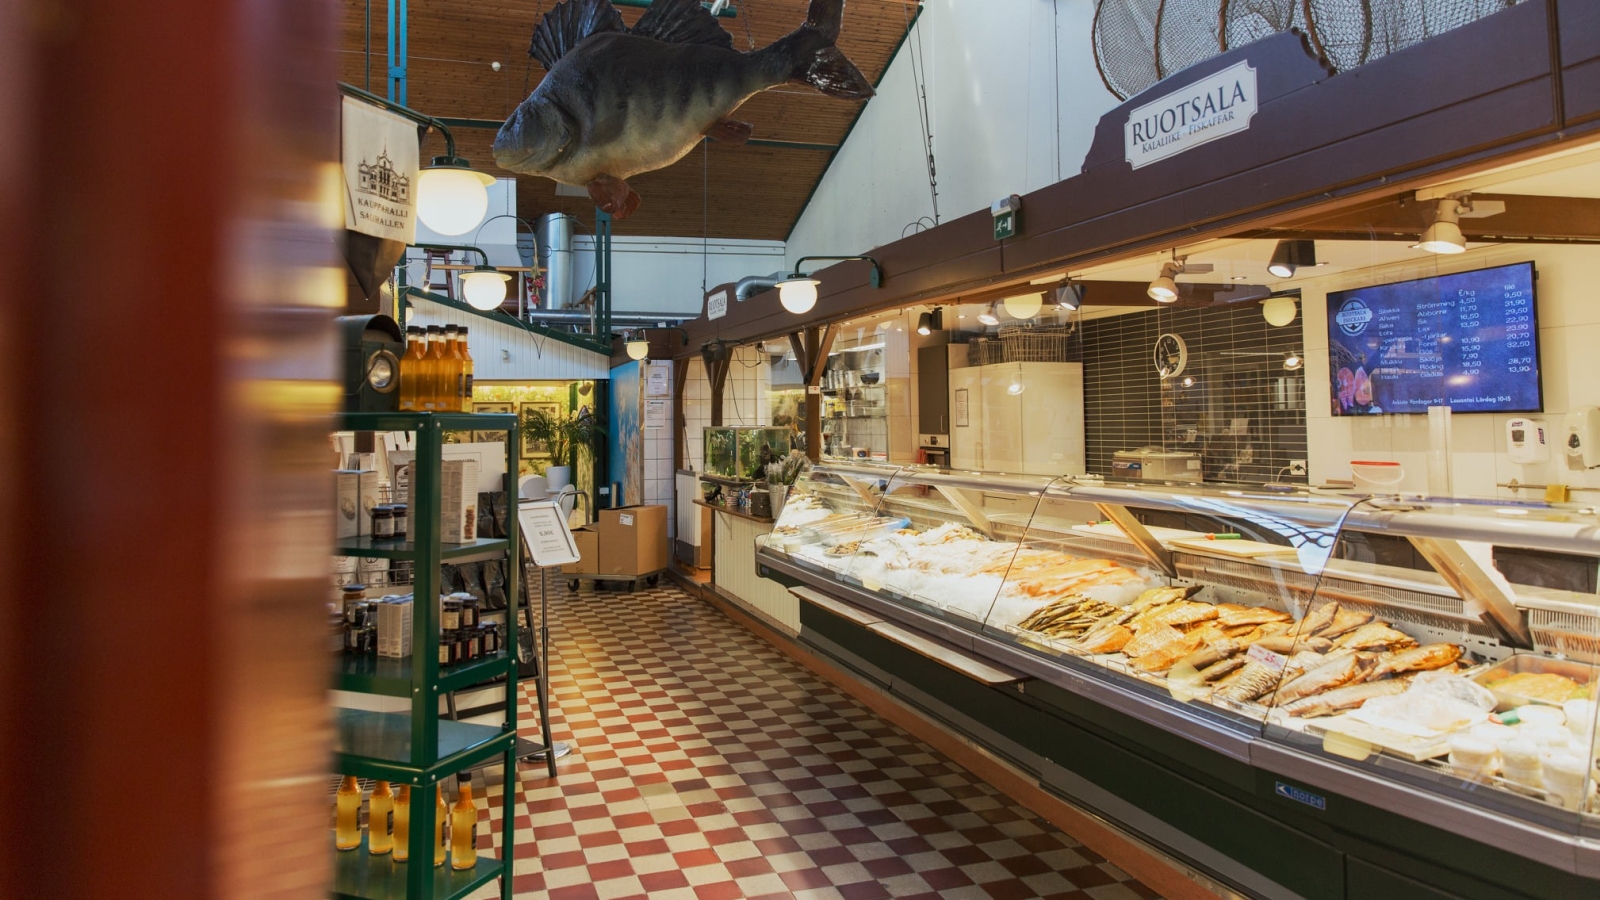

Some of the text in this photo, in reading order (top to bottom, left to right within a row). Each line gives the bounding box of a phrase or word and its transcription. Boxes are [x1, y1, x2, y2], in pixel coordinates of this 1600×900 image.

[1132, 80, 1248, 146] RUOTSALA
[1142, 132, 1181, 154] KALALIIKE
[1188, 110, 1235, 135] FISKAFFÄR
[357, 197, 408, 218] KAUPPAHALLI
[1416, 300, 1456, 309] Strömming
[1458, 297, 1476, 305] 4,50
[1417, 309, 1447, 317] Abborre
[1459, 305, 1477, 313] 11,70
[1504, 299, 1526, 307] 31,90
[1505, 307, 1528, 315] 29,50
[1505, 315, 1529, 323] 22,90
[1418, 340, 1438, 348] Forell
[1506, 332, 1530, 340] 20,70
[1506, 340, 1530, 348] 32,50
[1462, 352, 1479, 360] 7,90
[1420, 363, 1444, 371] Röding
[1508, 357, 1532, 365] 28,70
[1475, 396, 1496, 404] Lördag
